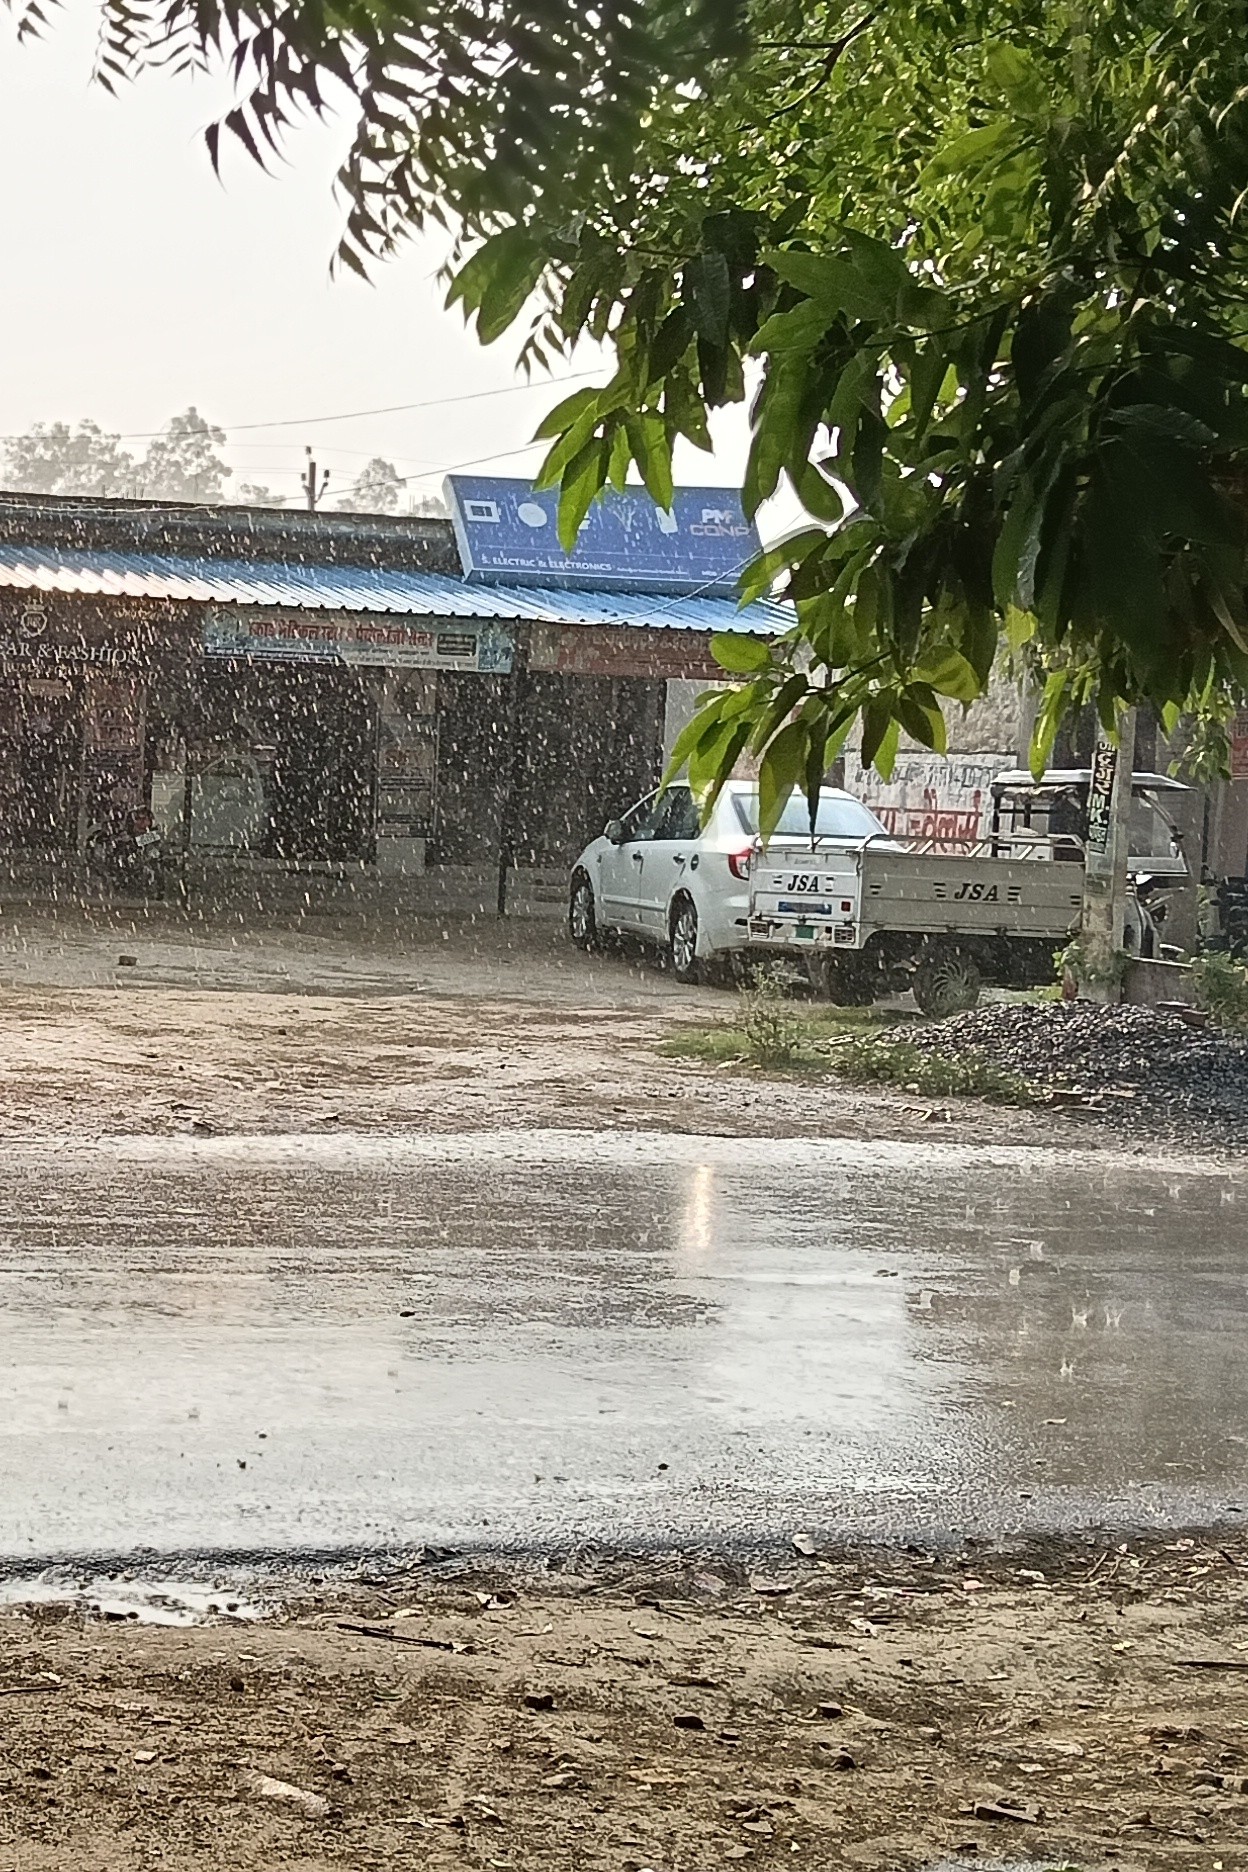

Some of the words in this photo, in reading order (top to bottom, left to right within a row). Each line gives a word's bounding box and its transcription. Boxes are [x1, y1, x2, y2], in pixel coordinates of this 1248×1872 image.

[492, 556, 535, 568] ELECTRIC
[549, 559, 612, 571] ELECTRONICS
[58, 645, 142, 664] FASHION
[787, 874, 819, 893] JSA
[954, 882, 999, 902] JSA
